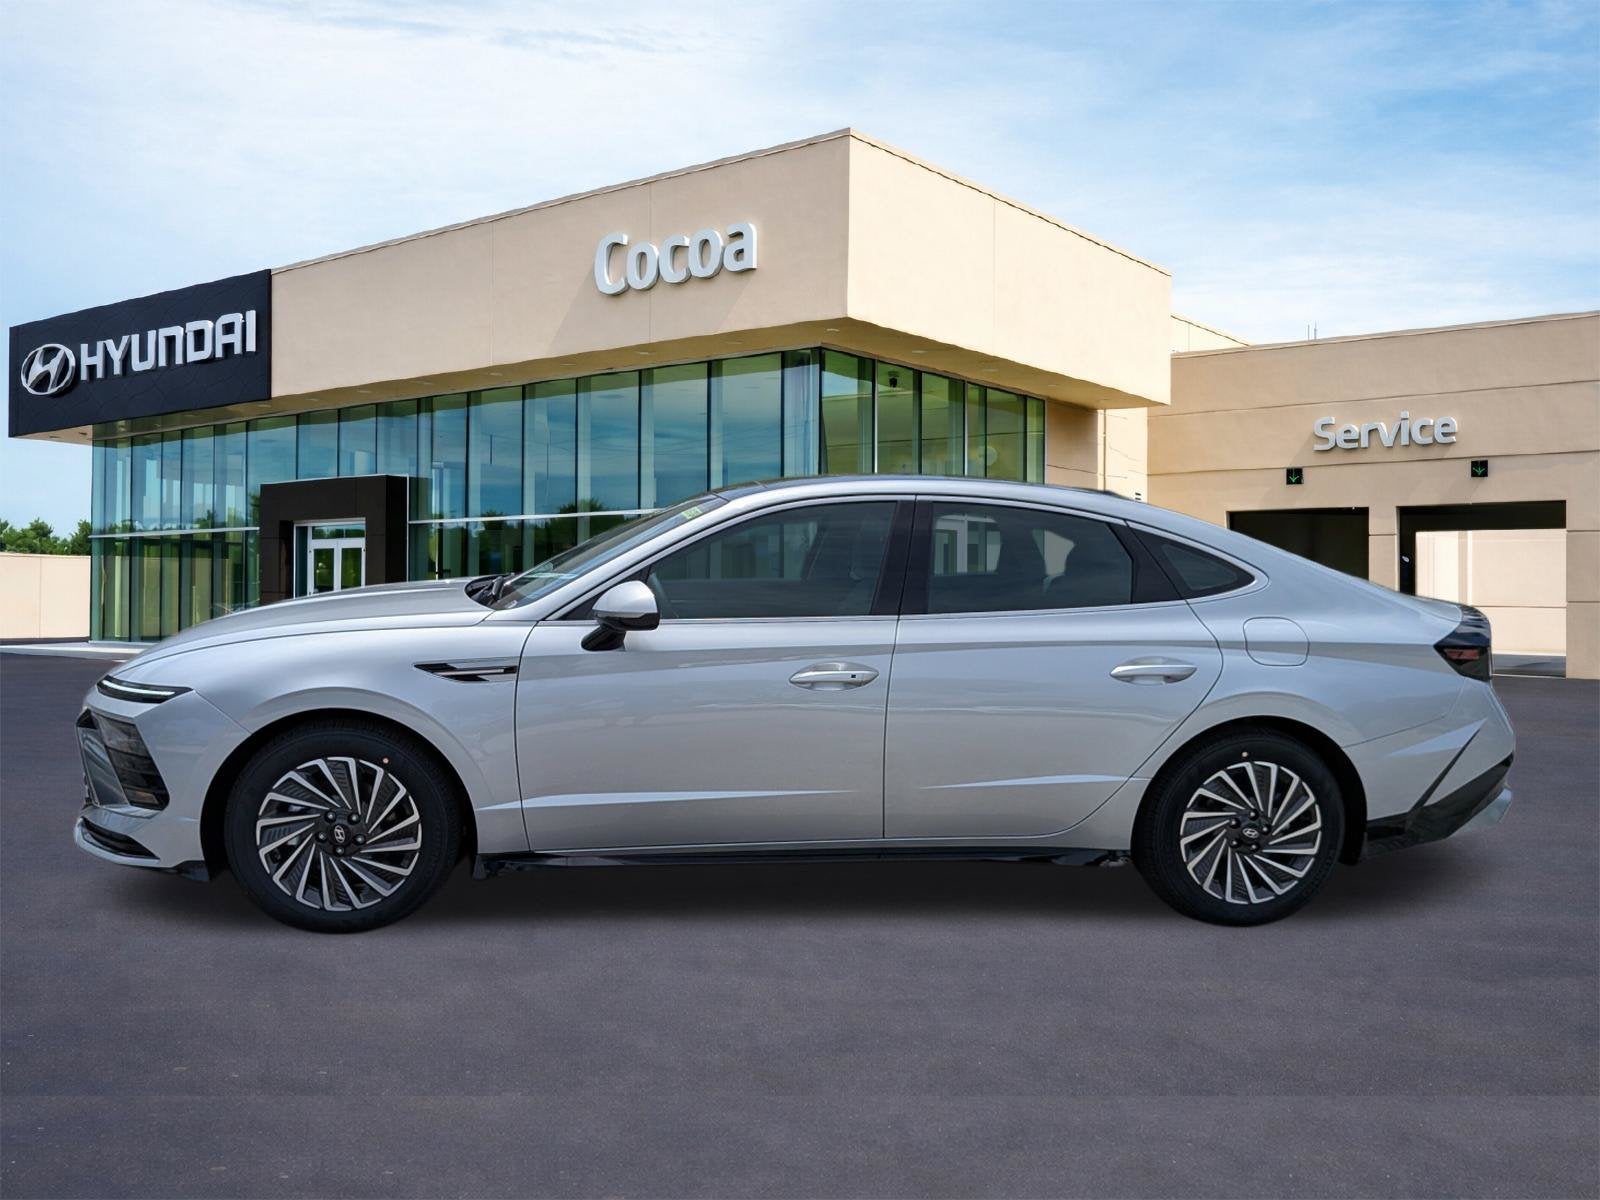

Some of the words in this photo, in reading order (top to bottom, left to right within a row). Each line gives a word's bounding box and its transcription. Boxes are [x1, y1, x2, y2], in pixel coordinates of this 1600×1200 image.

[594, 222, 758, 296] Cocoa
[80, 309, 257, 381] HYUNDAI
[1312, 410, 1459, 451] Service
